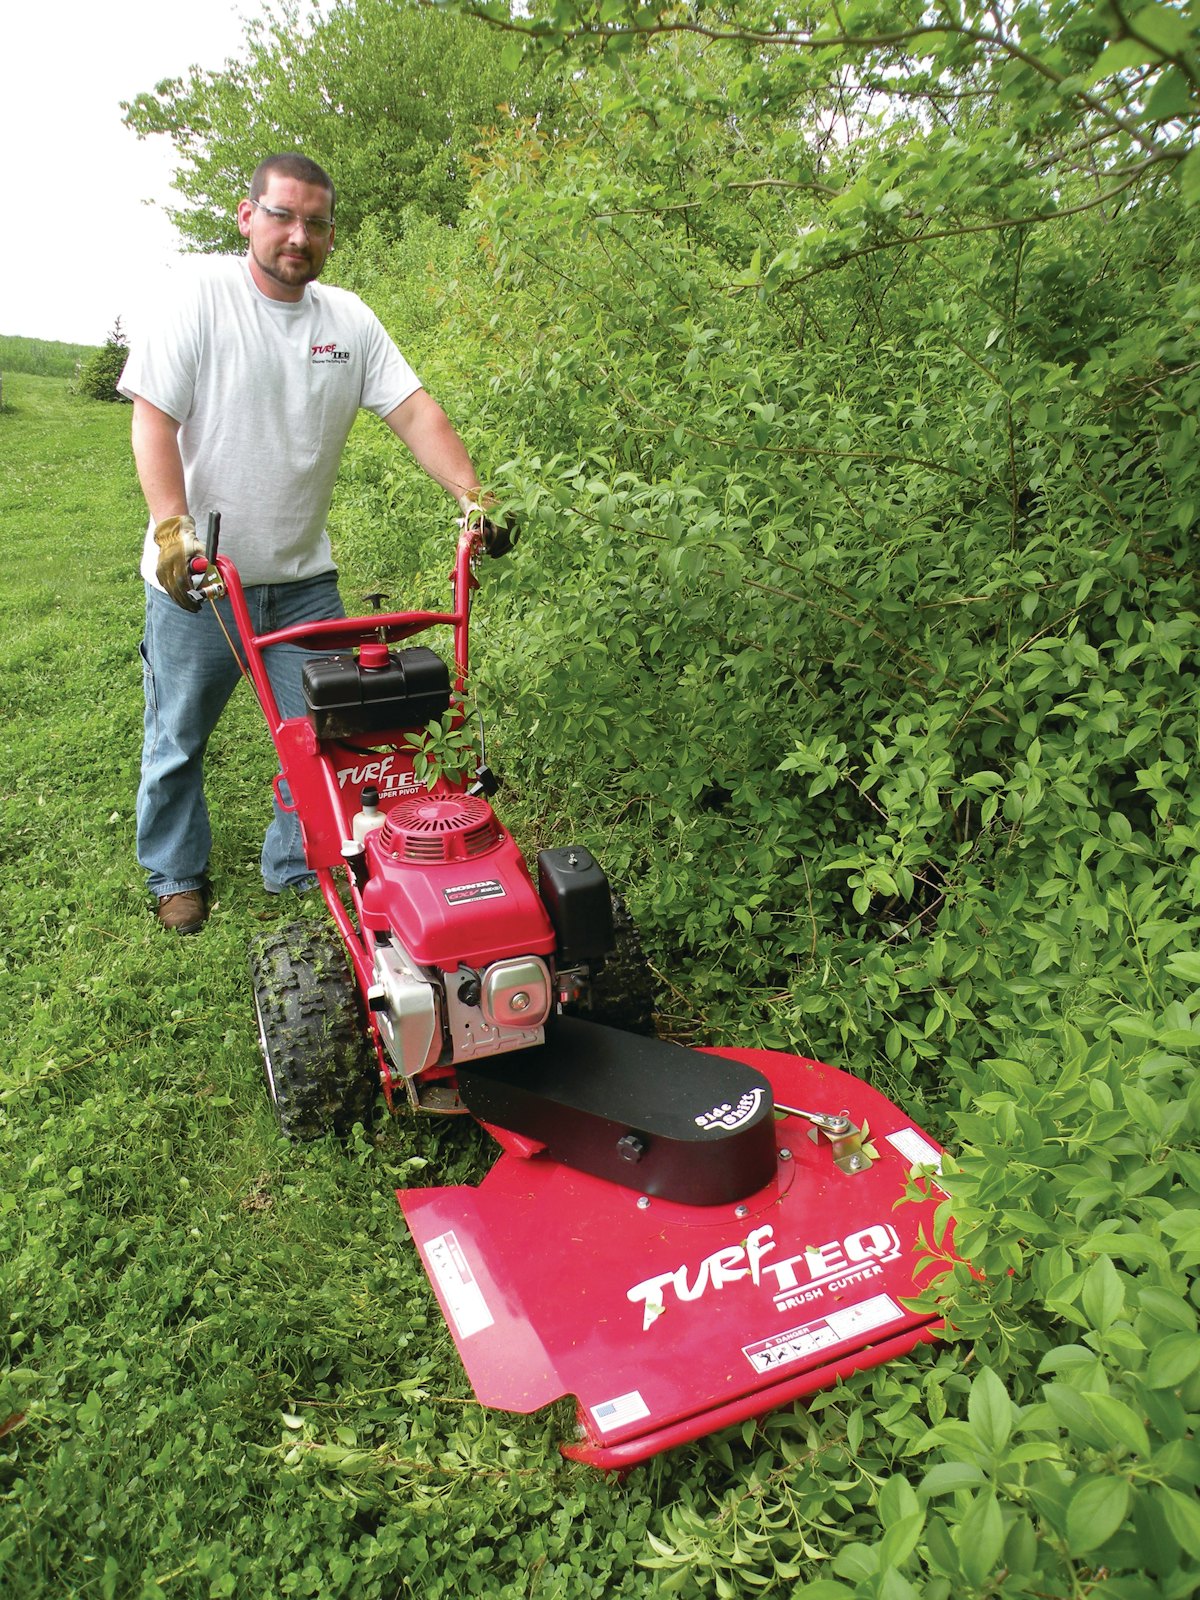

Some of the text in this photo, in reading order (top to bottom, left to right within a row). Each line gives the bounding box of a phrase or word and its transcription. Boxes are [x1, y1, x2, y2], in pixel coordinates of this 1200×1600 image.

[311, 344, 337, 357] TURF
[336, 755, 395, 789] TURF
[378, 787, 420, 800] UPER PIVOT
[445, 880, 497, 894] HONDA
[448, 889, 480, 900] GXV
[694, 1094, 755, 1126] Side Shift
[626, 1224, 776, 1331] TURF
[762, 1223, 903, 1294] TEQ
[775, 1265, 884, 1313] BRUSH CUTTER
[774, 1326, 810, 1345] DANGER
